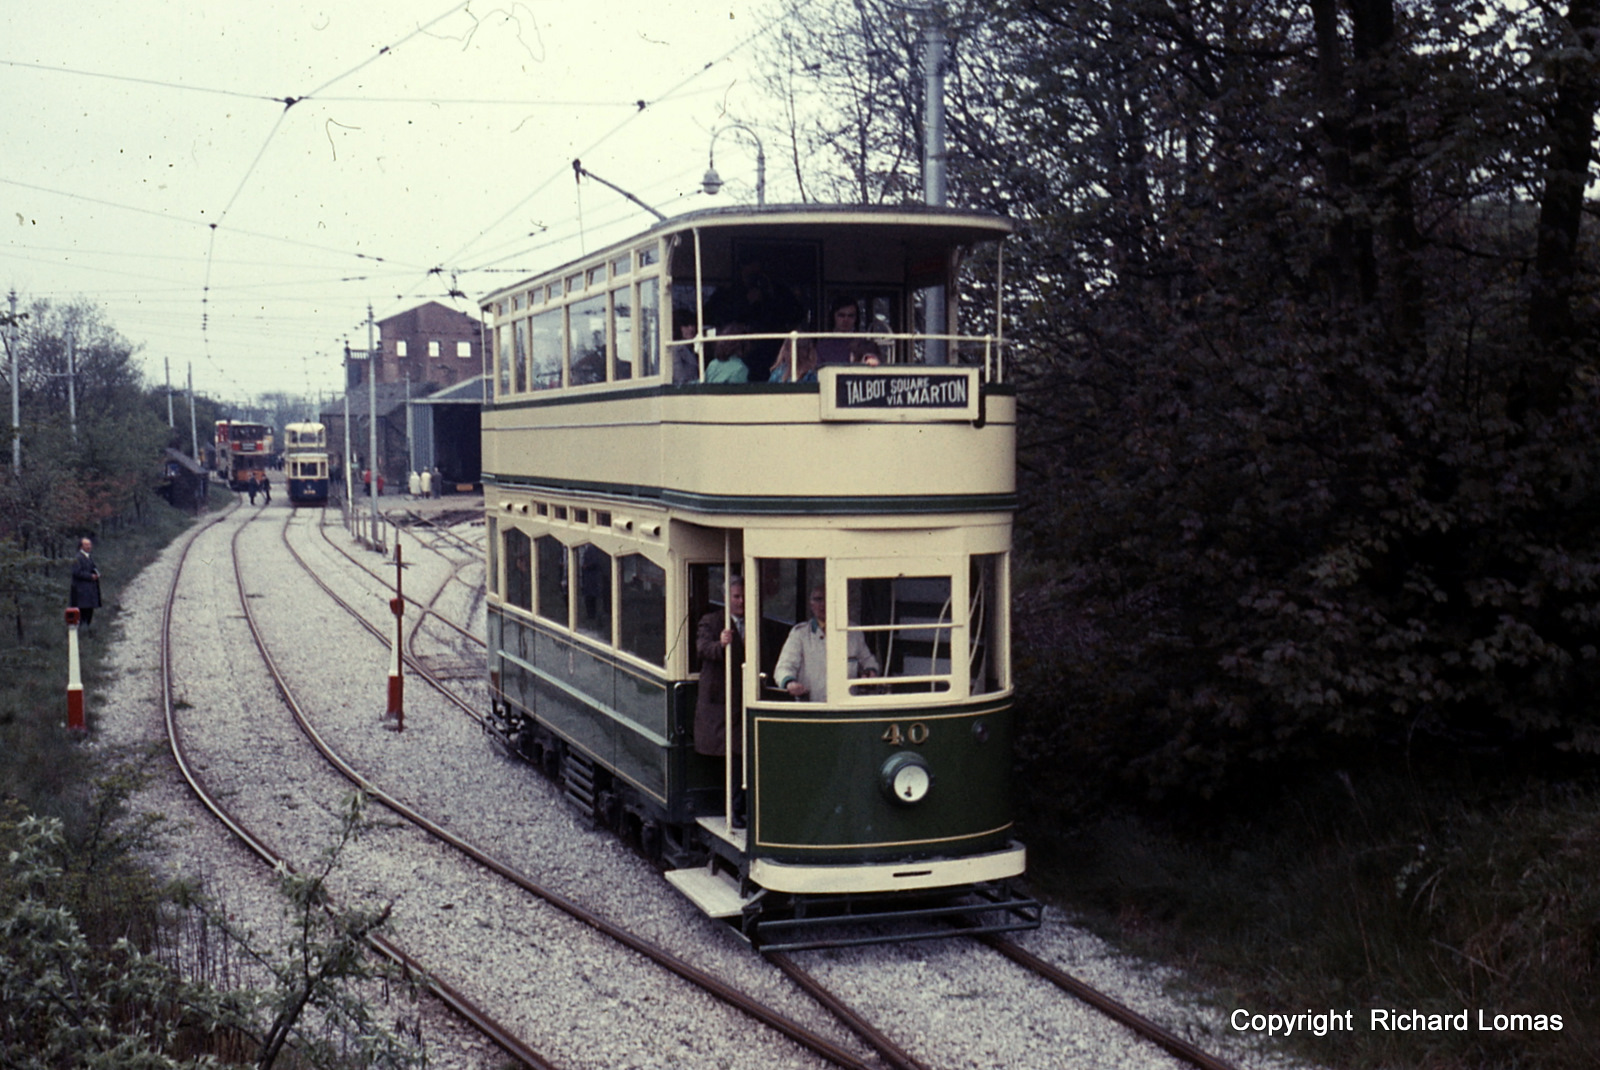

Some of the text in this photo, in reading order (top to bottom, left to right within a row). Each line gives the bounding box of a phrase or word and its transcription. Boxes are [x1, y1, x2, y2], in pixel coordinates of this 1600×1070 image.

[846, 377, 929, 405] TALBOT SQUARE
[886, 378, 966, 406] VIA MARTON
[881, 722, 929, 745] 40
